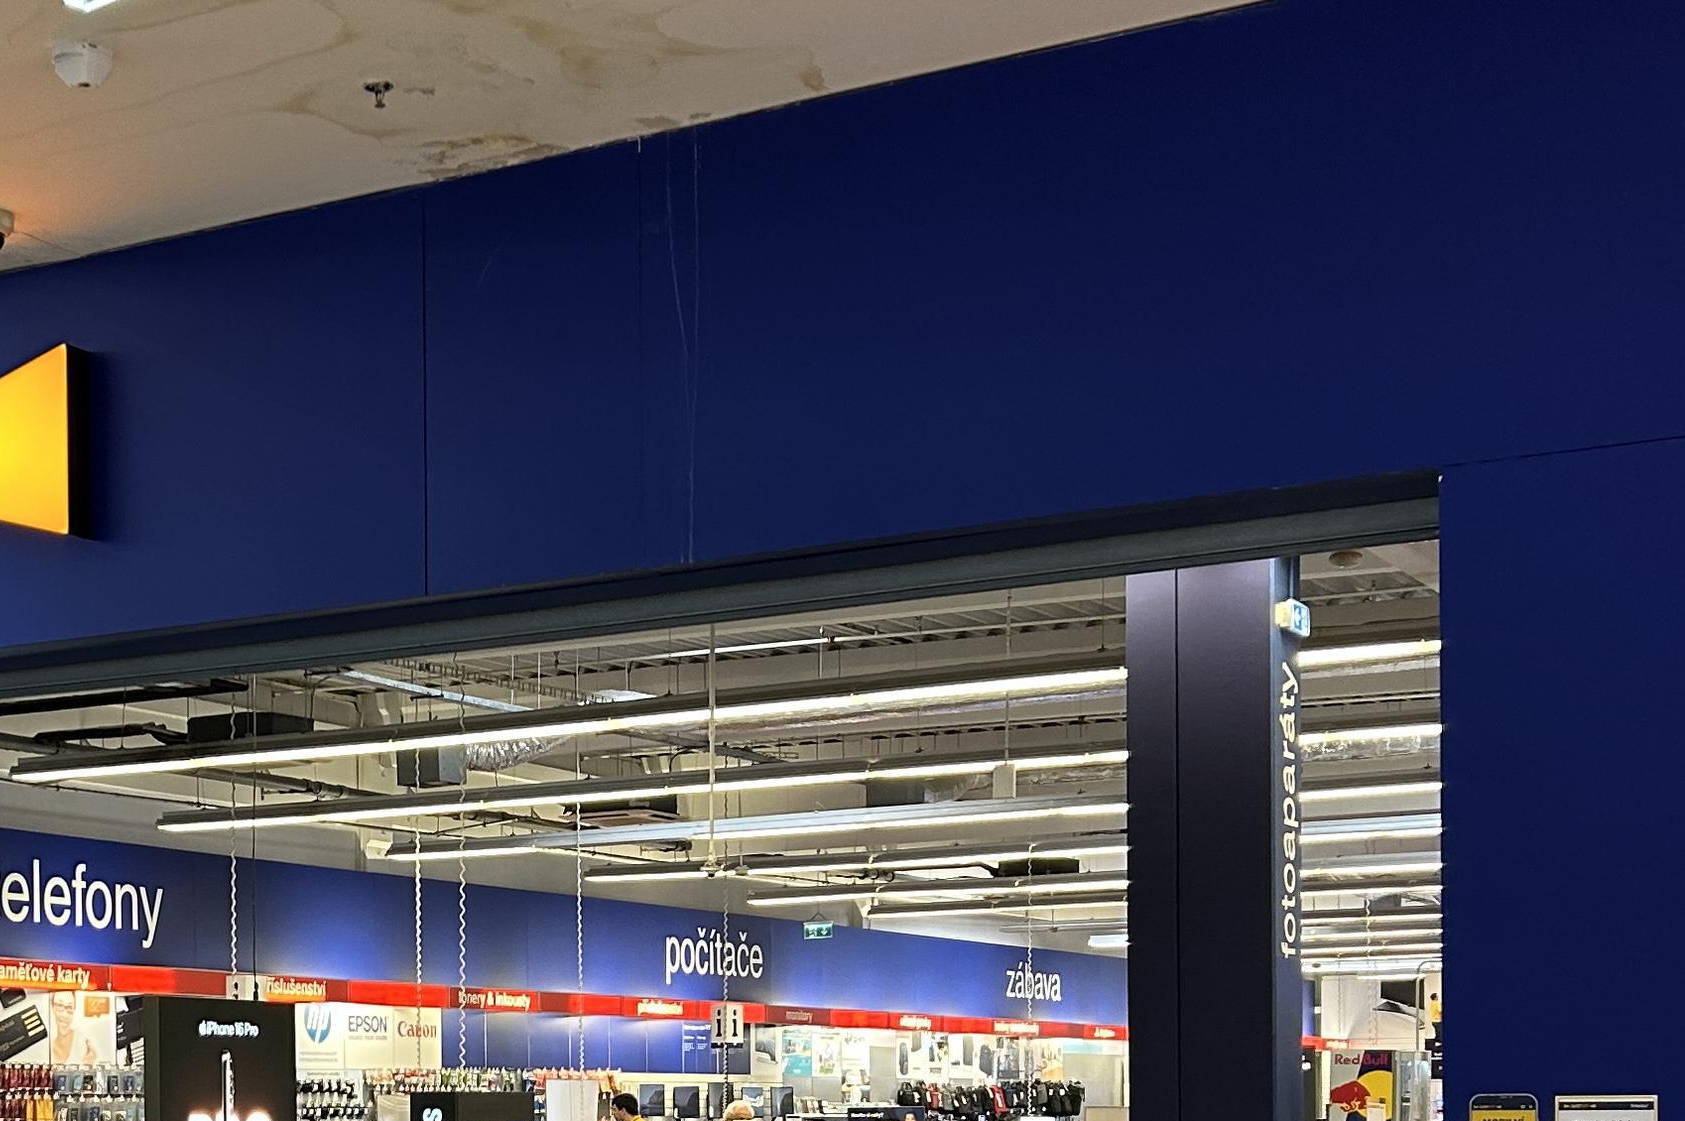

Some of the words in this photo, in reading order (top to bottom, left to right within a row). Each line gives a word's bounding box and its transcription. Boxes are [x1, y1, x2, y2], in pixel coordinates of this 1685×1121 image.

[1279, 661, 1299, 959] fotoaparáty
[665, 926, 764, 985] počítače
[57, 966, 91, 989] karty
[1005, 961, 1062, 1002] zábava
[348, 1015, 388, 1033] EPSON
[397, 1020, 437, 1039] Canon
[1334, 1053, 1360, 1066] Red
[1363, 1053, 1389, 1066] Bull
